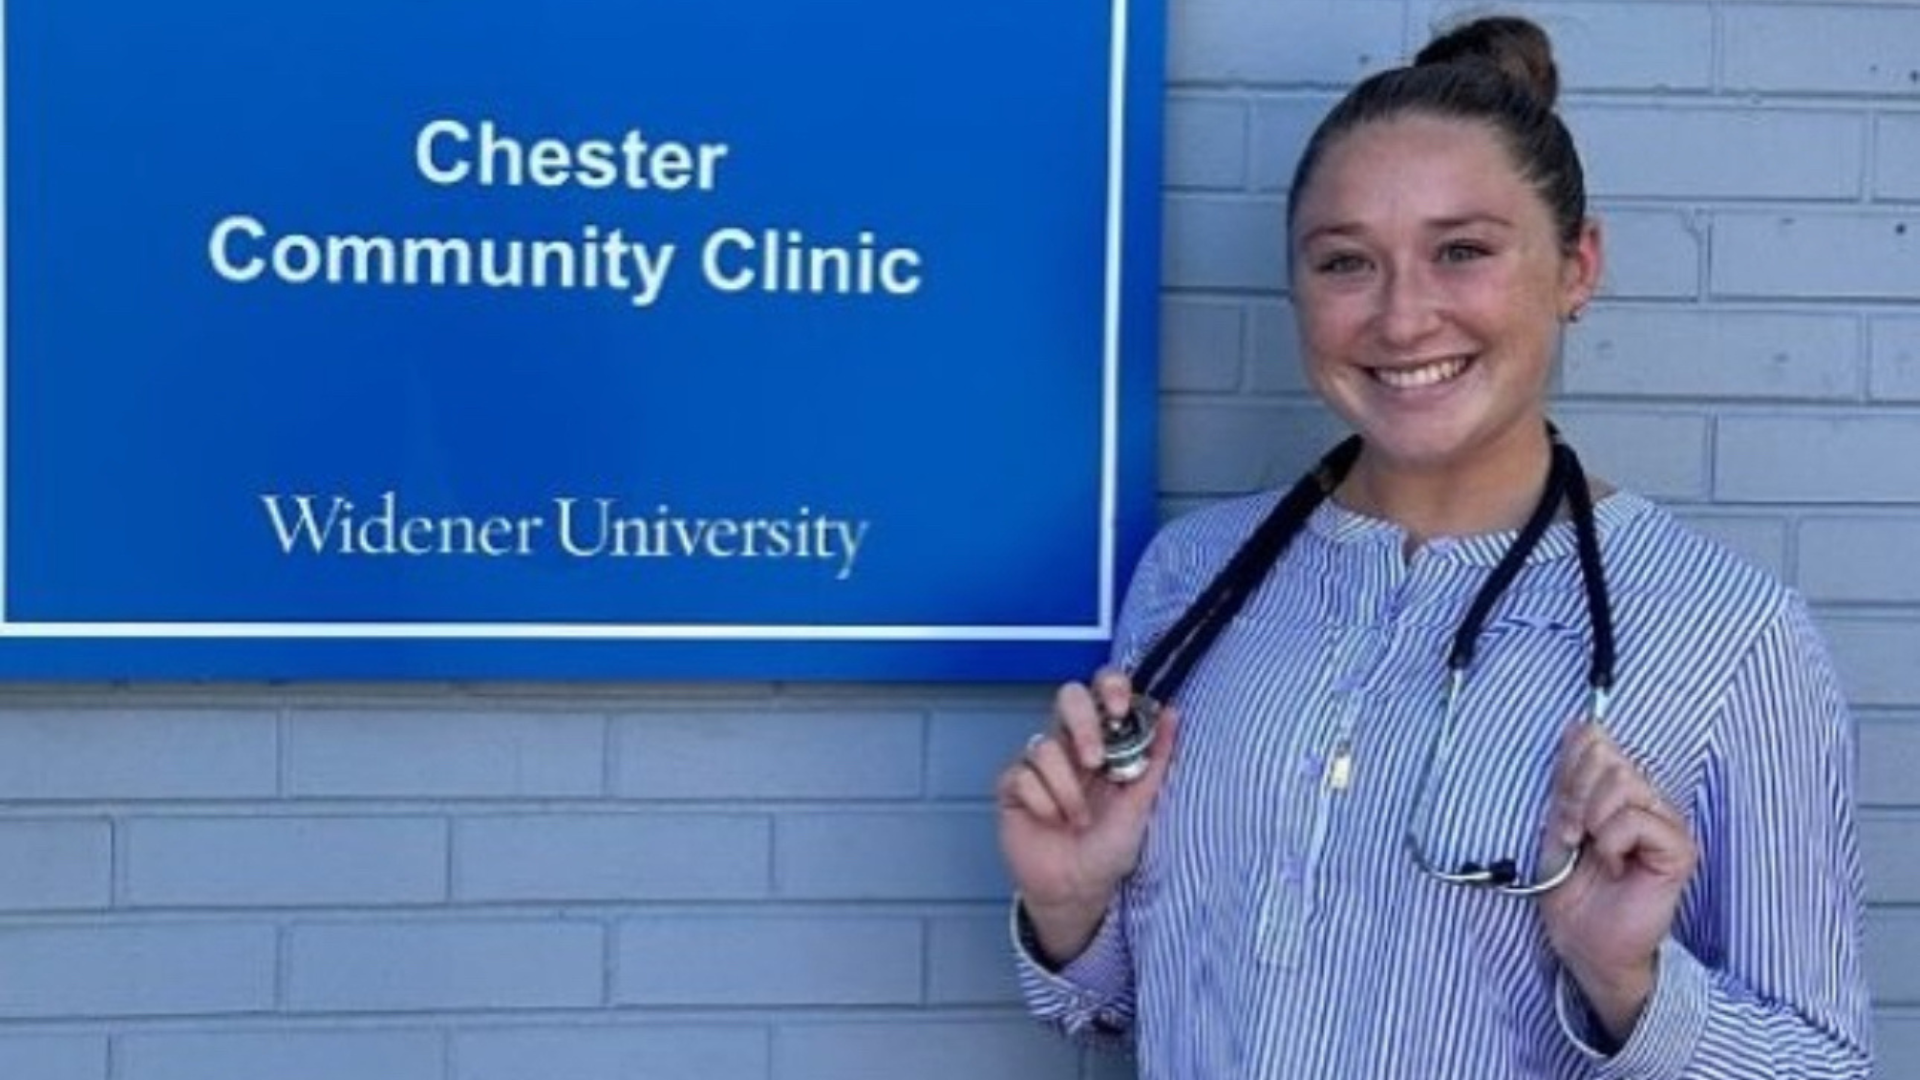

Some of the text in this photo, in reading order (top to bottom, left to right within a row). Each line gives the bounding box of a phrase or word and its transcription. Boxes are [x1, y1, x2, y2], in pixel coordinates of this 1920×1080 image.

[416, 119, 729, 191] Chester
[208, 215, 922, 307] Community Clinic
[261, 491, 869, 580] Widener University
